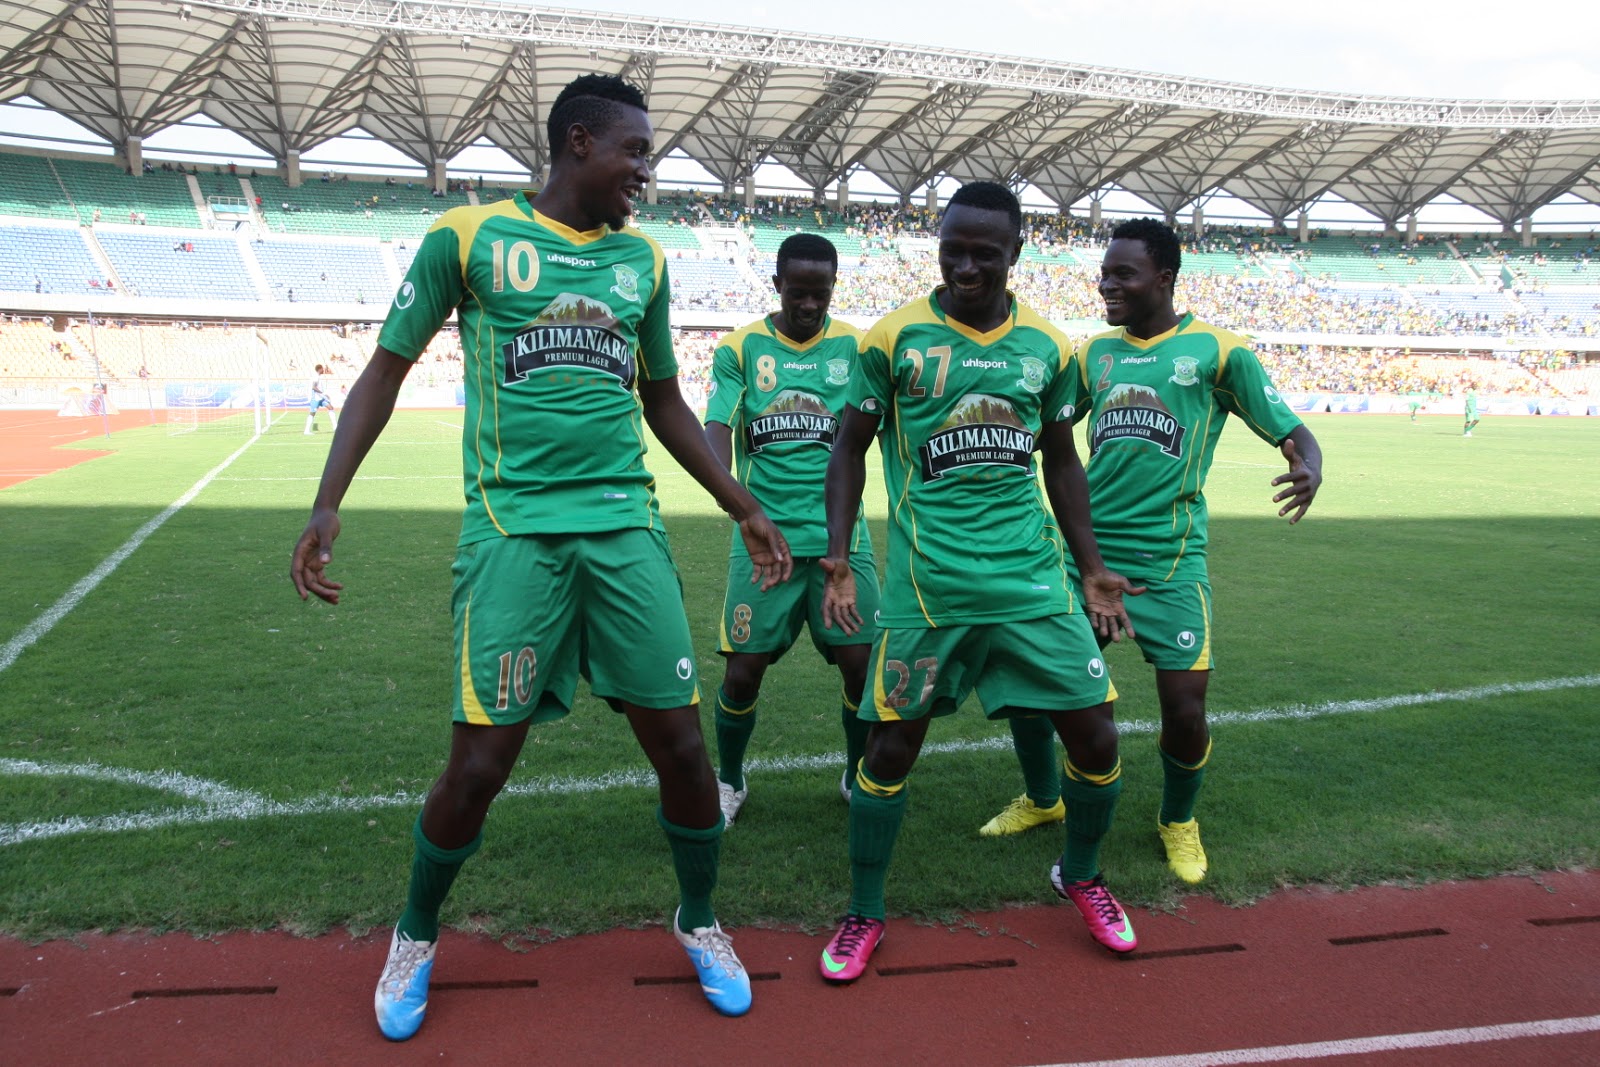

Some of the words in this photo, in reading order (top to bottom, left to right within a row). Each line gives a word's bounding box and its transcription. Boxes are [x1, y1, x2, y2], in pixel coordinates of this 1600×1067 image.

[491, 240, 540, 292] 10
[547, 254, 597, 267] uhlsport
[516, 328, 628, 366] KILIMANJARO
[544, 352, 584, 363] PREMIUM
[586, 355, 609, 368] LAGER
[1120, 356, 1156, 364] uhlsport
[756, 354, 777, 393] 8
[783, 362, 817, 370] uhlsport
[903, 345, 952, 399] 27
[962, 358, 1008, 370] uhlsport
[1096, 354, 1114, 393] 2
[752, 415, 836, 436] KILIMANJARO
[1095, 409, 1175, 437] KILIMANJARO
[1104, 428, 1130, 437] PREMIUM
[1131, 428, 1151, 437] LAGER
[928, 427, 1034, 459] KILIMANJARO
[955, 452, 991, 463] PREMIUM
[993, 452, 1015, 461] LAGER
[731, 603, 752, 644] 8
[496, 646, 537, 711] 10
[884, 656, 938, 708] 27
